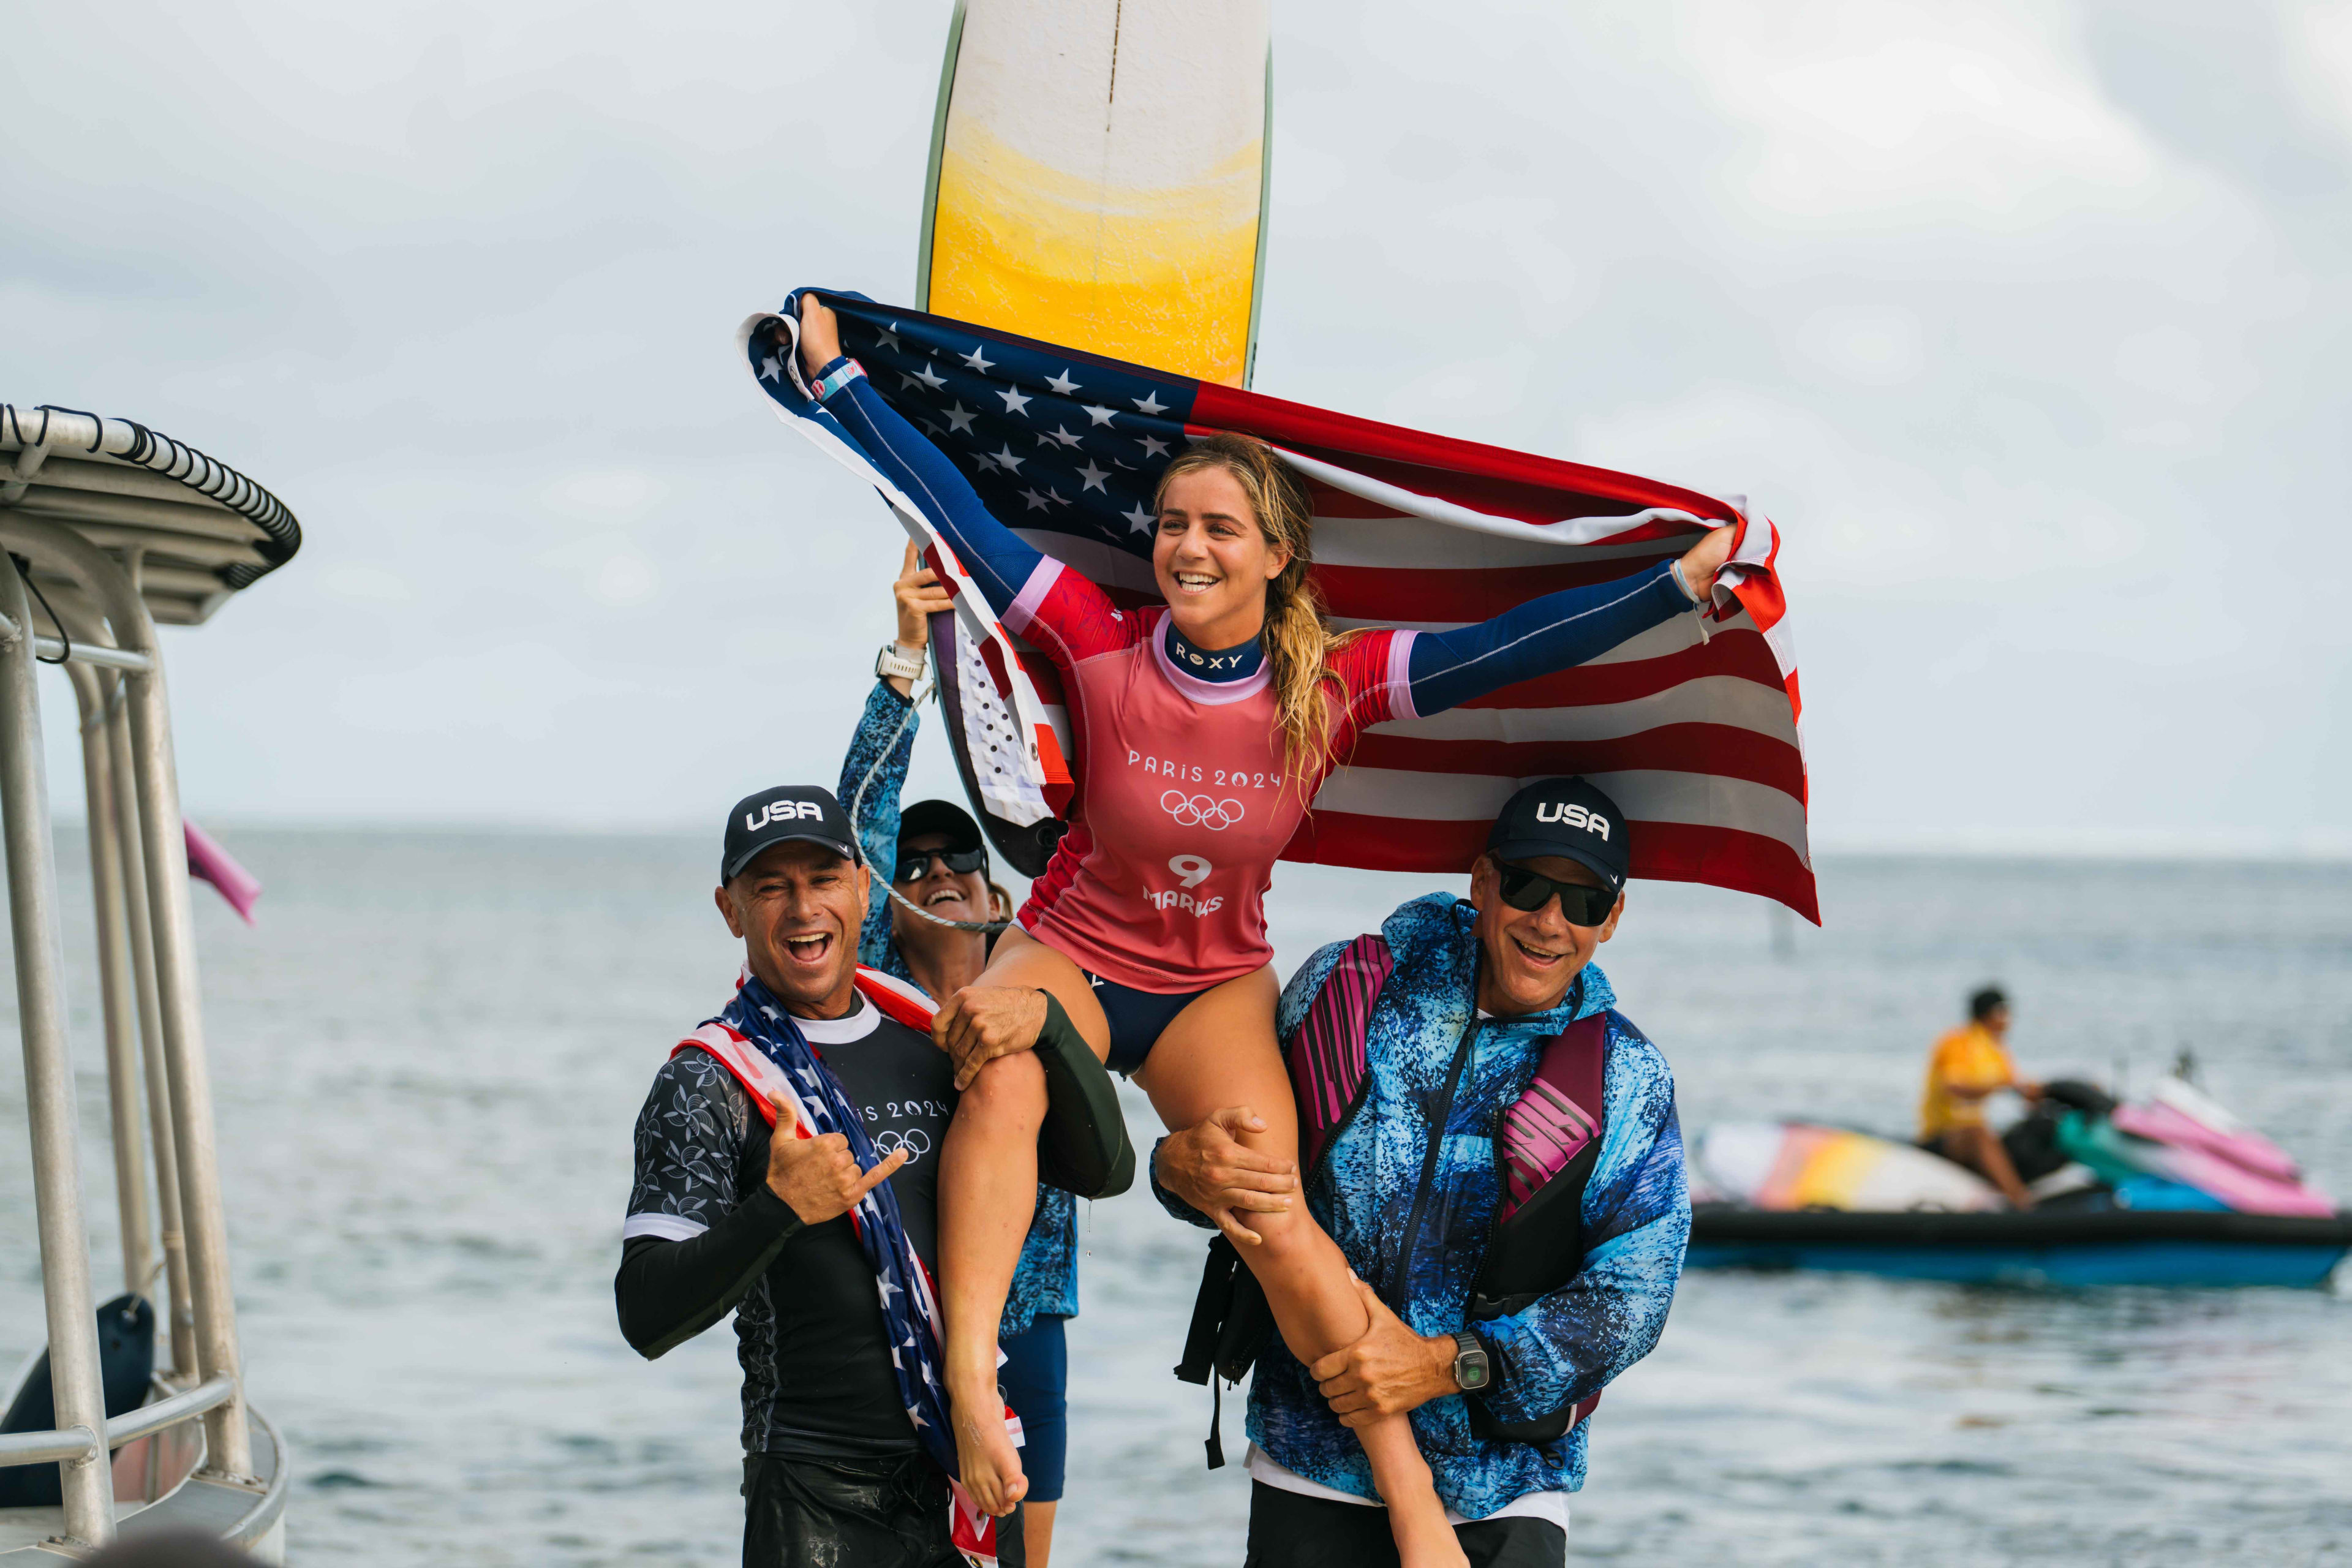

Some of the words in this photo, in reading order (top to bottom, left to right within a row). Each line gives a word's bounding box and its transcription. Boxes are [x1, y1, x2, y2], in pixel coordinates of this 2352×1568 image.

[1175, 641, 1243, 669] ROXY
[1214, 769, 1280, 788] 2024
[745, 799, 824, 831] USA
[1536, 802, 1610, 842] USA
[1168, 854, 1213, 889] 9
[1142, 884, 1224, 919] MARKS
